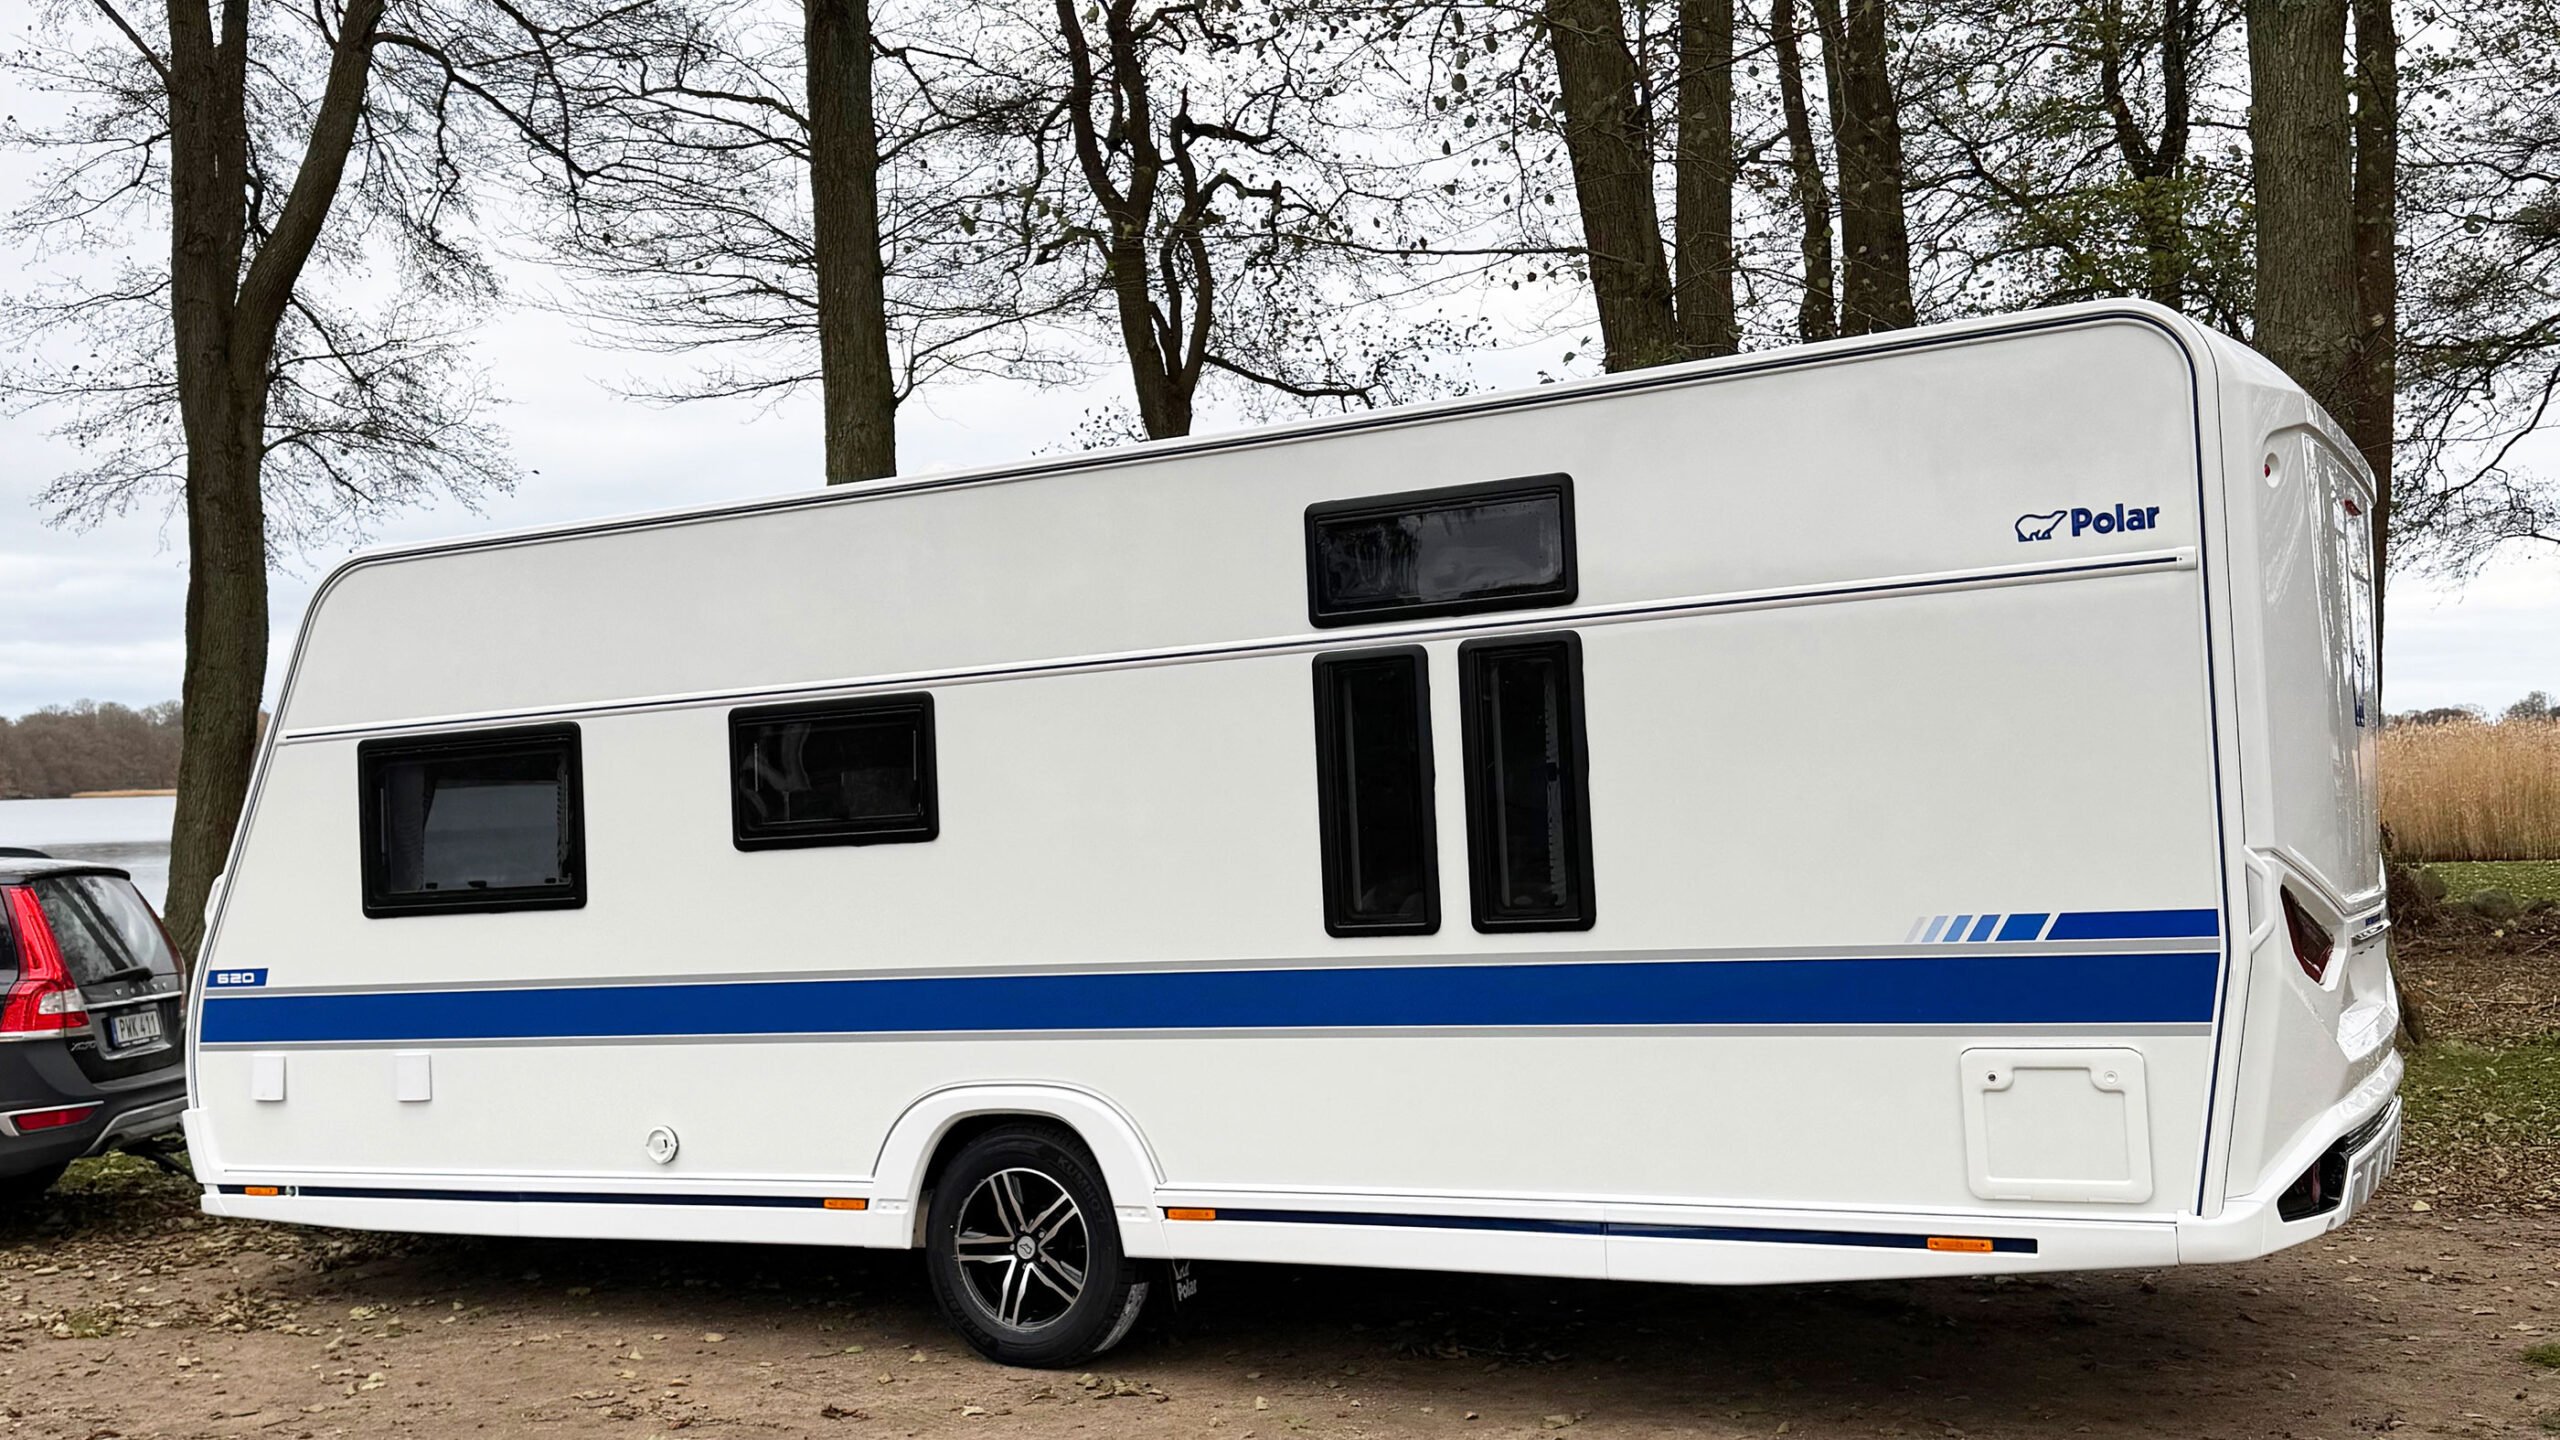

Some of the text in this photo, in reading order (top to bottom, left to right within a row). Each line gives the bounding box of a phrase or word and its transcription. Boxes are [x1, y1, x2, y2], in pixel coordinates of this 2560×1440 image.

[2070, 503, 2160, 537] Polar
[217, 973, 255, 985] 620
[1176, 1278, 1197, 1302] Polar
